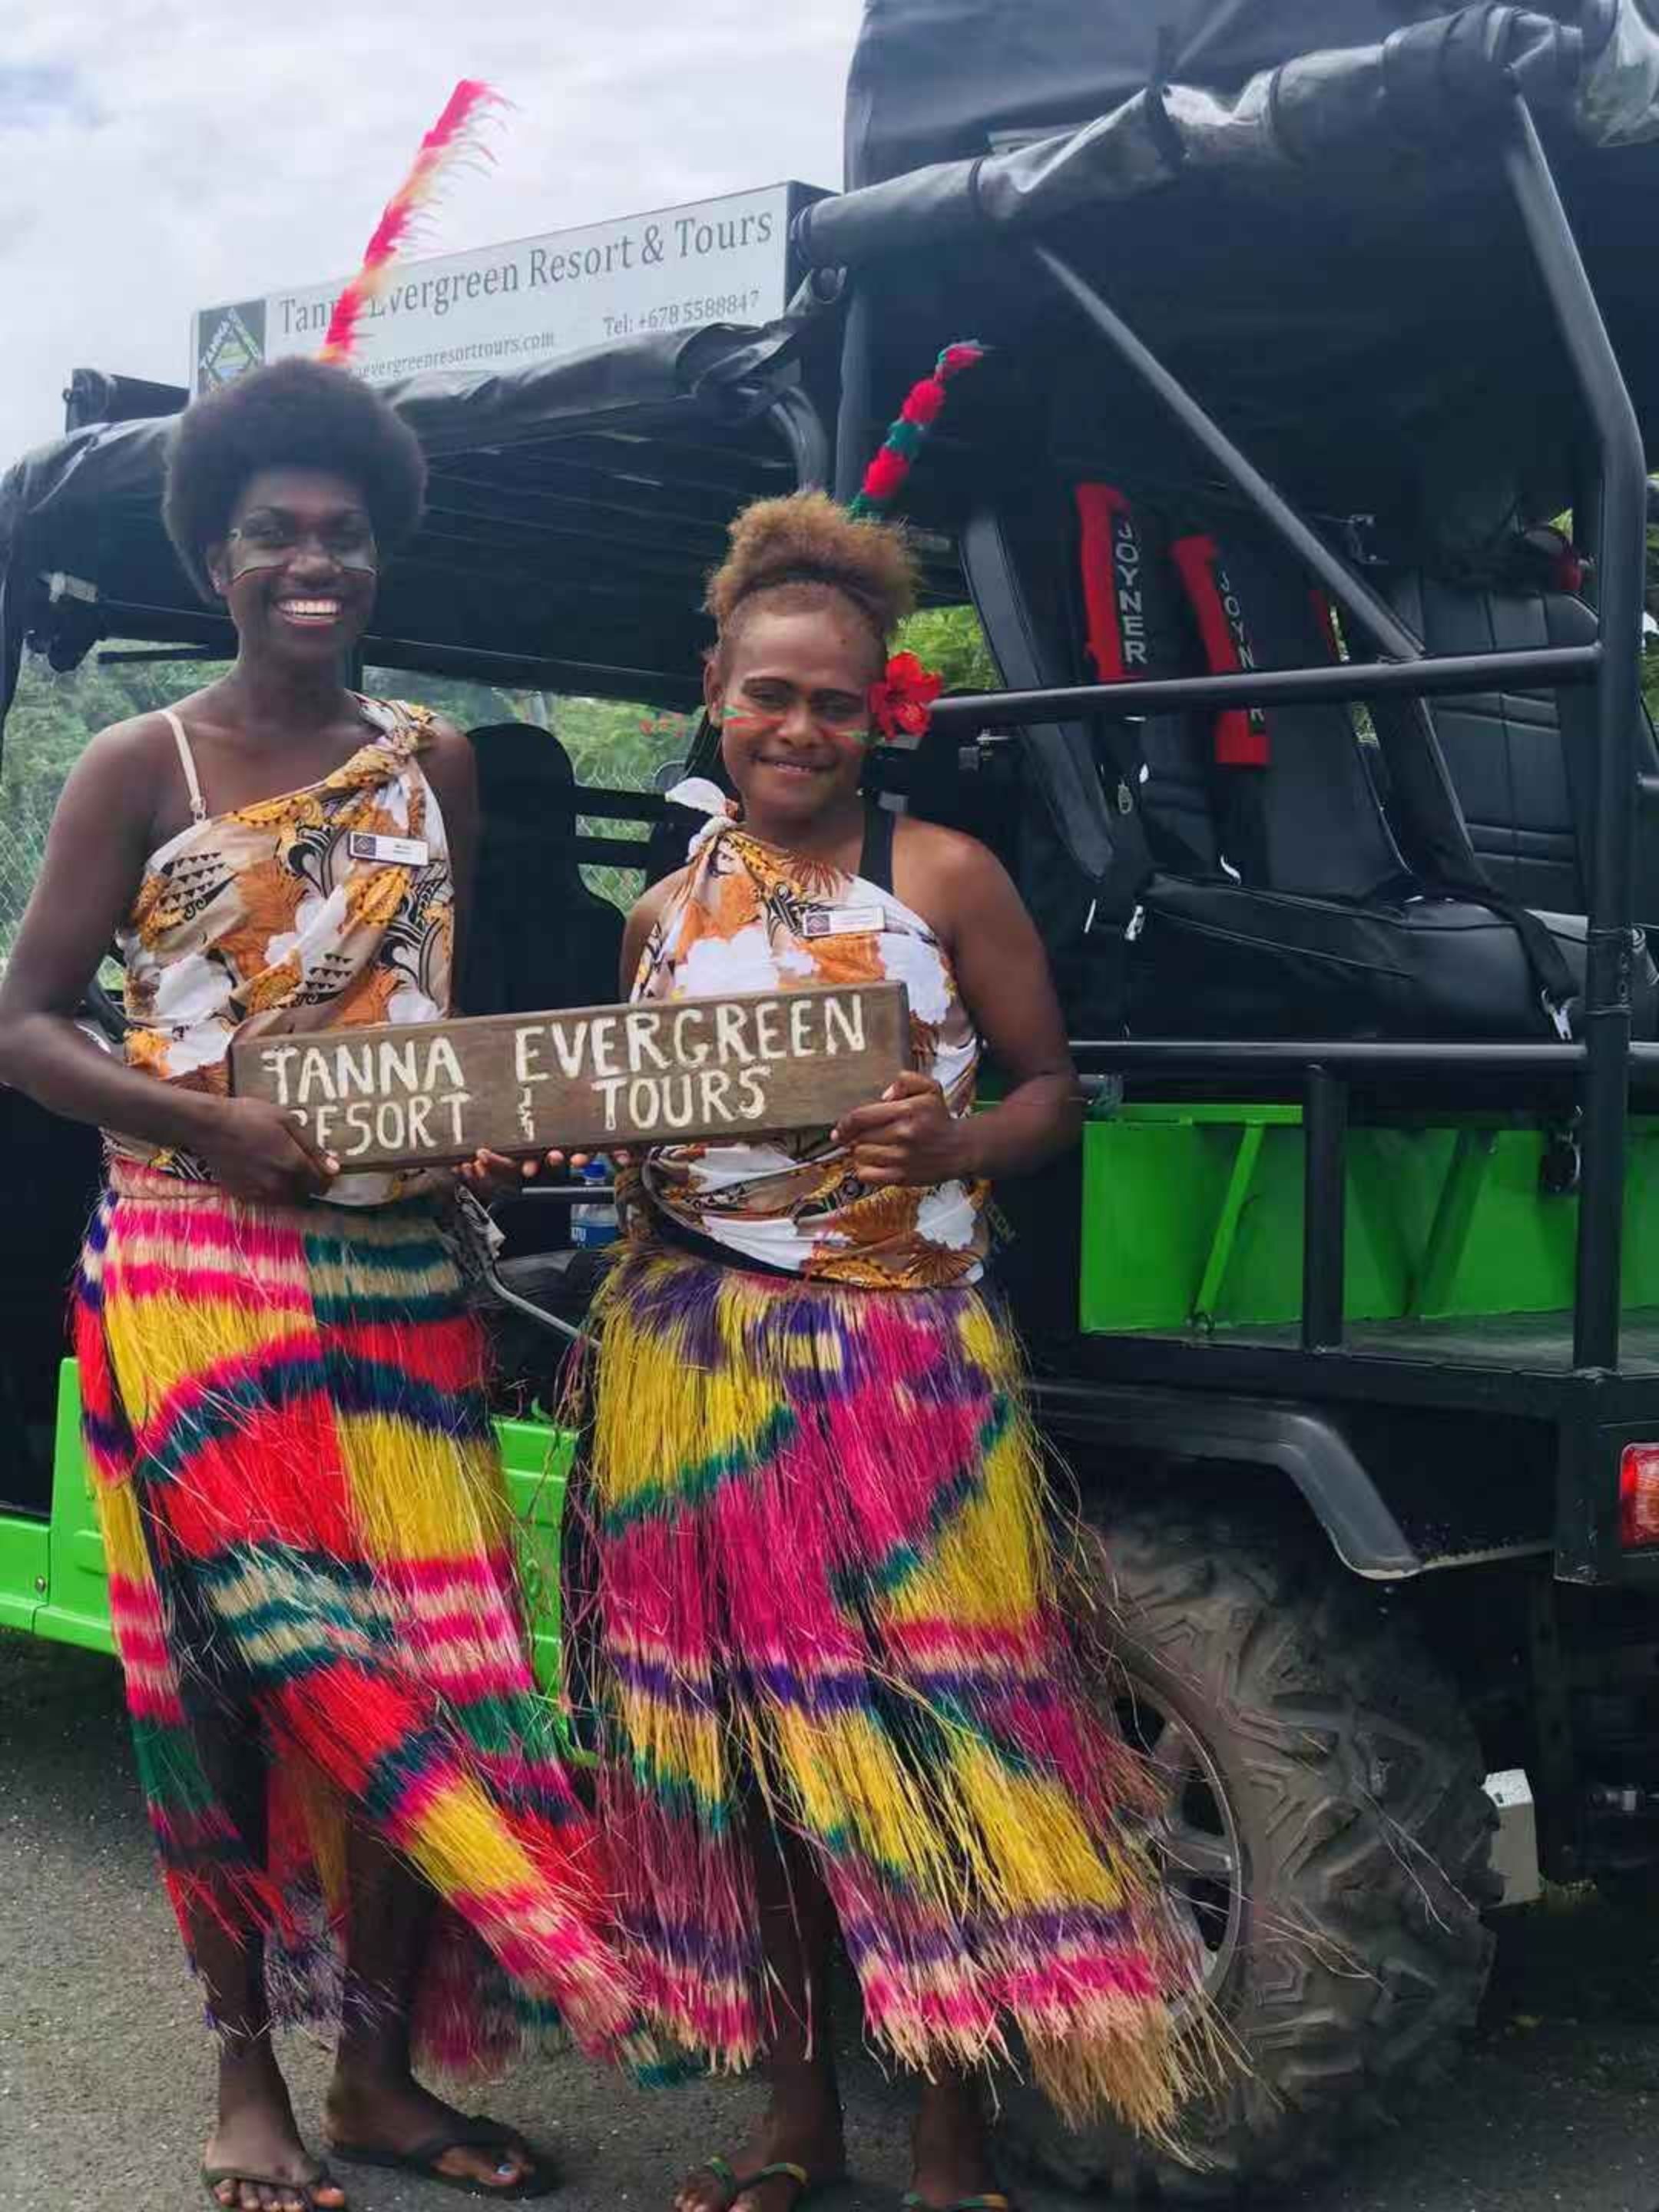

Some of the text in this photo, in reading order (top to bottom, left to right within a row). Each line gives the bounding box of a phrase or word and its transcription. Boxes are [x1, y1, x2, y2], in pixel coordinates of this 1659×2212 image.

[280, 297, 339, 334] Tan
[528, 233, 635, 288] Resort
[641, 224, 665, 265] &
[674, 212, 773, 259] Tours
[602, 313, 634, 338] Tel:
[638, 304, 679, 329] +678
[1115, 522, 1148, 665] JOYNER
[1220, 571, 1265, 722] JOYNR
[260, 994, 866, 1105] TANNA EVERGREEN
[591, 1064, 773, 1131] TOURS
